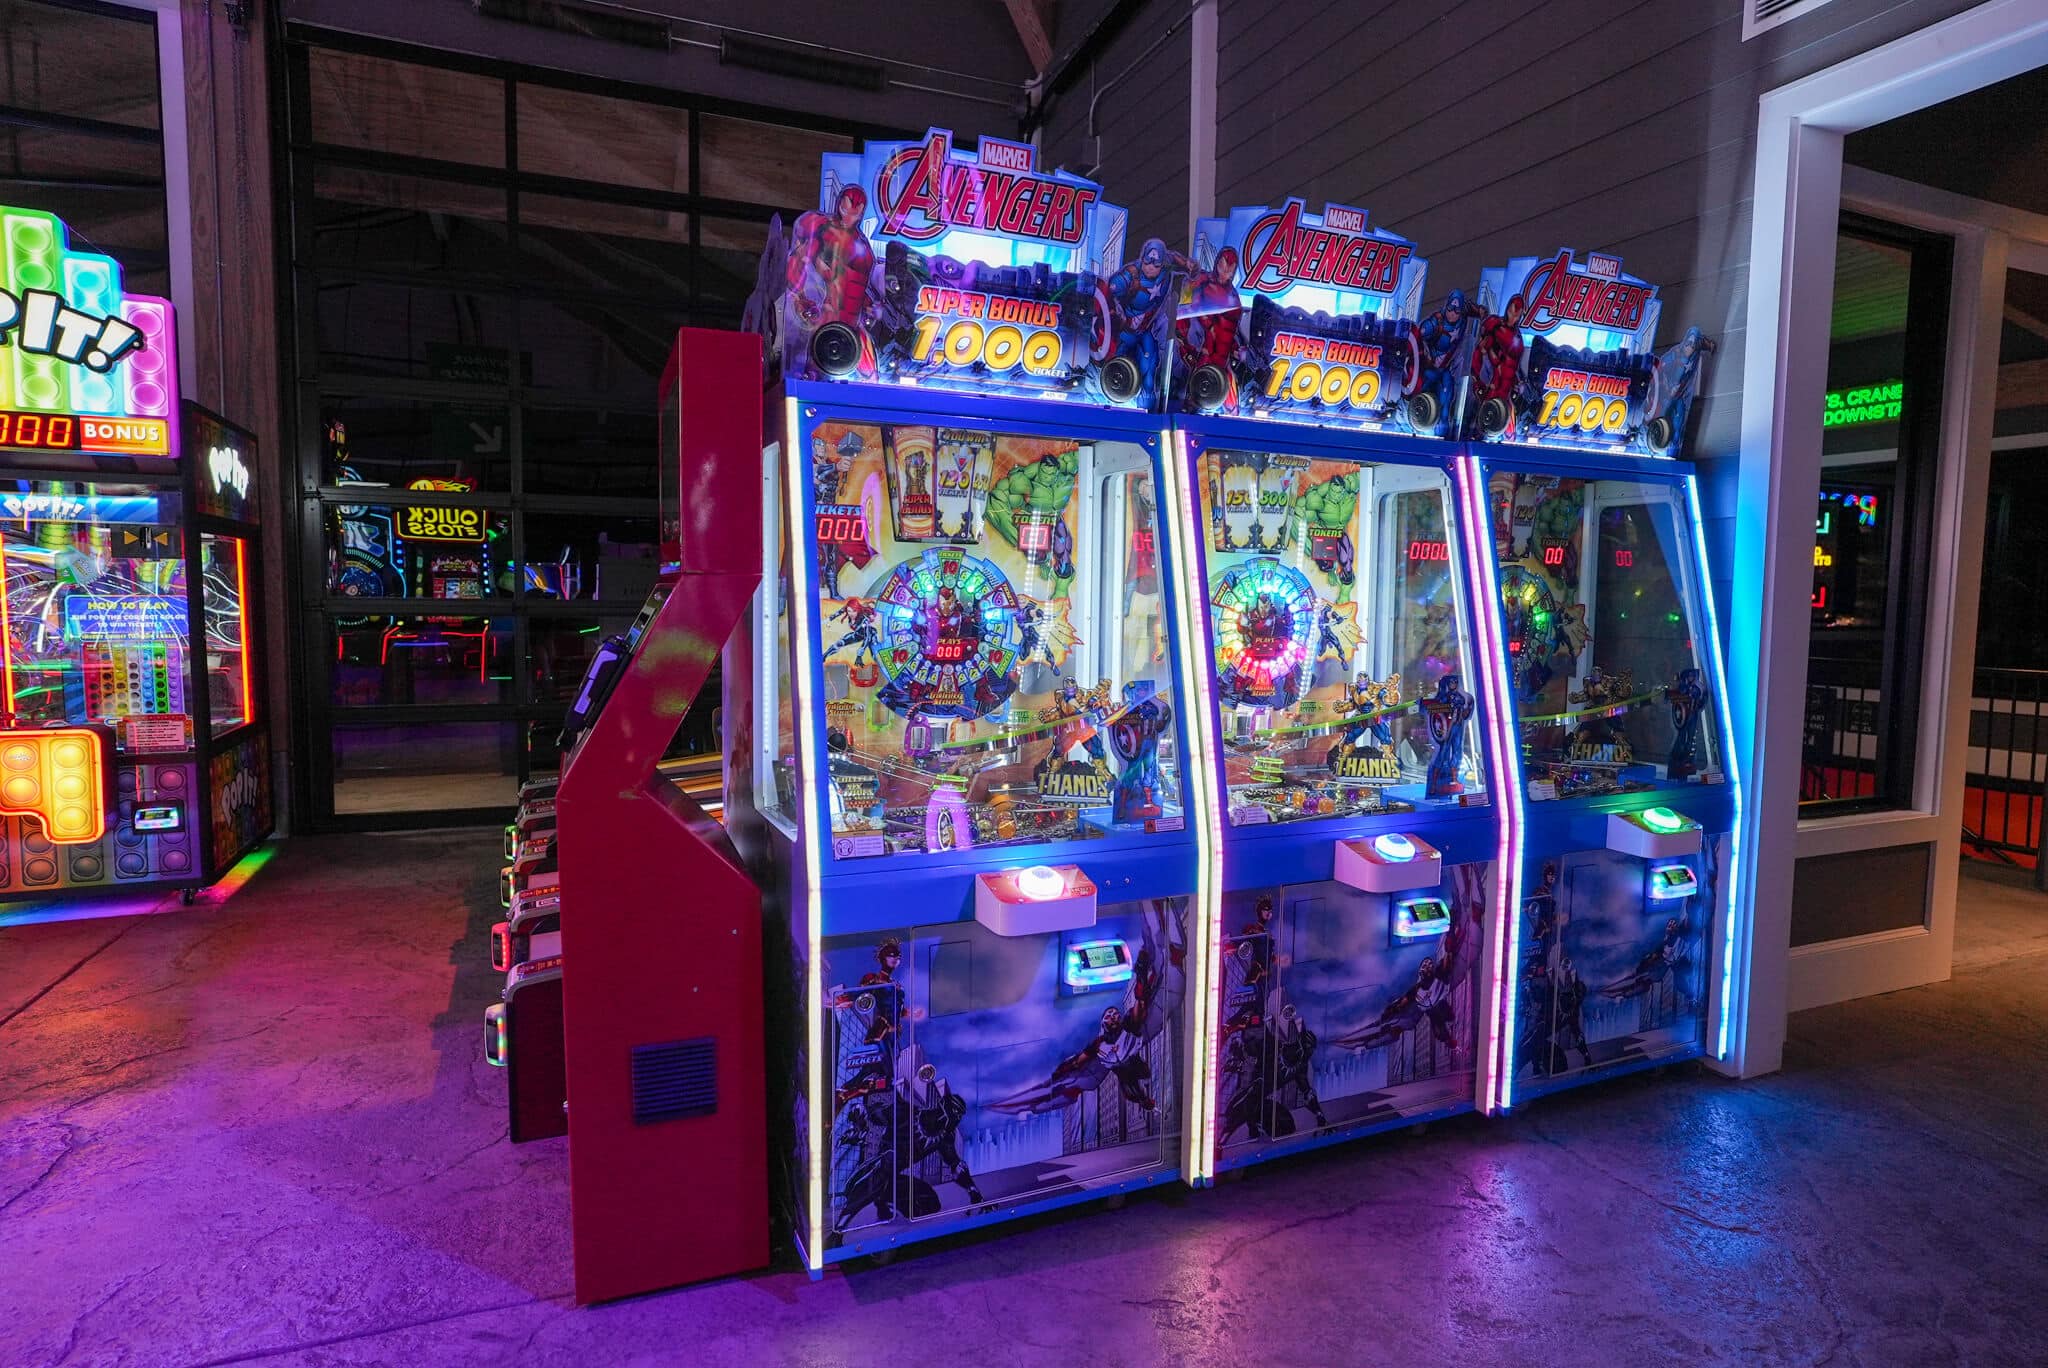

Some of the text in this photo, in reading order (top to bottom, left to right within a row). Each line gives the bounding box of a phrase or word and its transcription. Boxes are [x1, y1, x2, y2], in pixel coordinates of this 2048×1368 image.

[984, 142, 1031, 171] MARVEL
[876, 135, 1098, 242] AVENGERS
[1328, 208, 1363, 232] MARVEL
[1243, 201, 1409, 293] AVENGERS
[1590, 257, 1619, 277] MARVEL
[1521, 252, 1653, 330] AVENGERS
[917, 287, 1061, 328] SUPER BONUS
[912, 316, 1062, 374] 1,000
[1272, 332, 1381, 367] SUPER BONUS
[1033, 367, 1066, 378] TICKETS
[1266, 359, 1380, 406] 1,000
[1546, 369, 1631, 396] SUPER BONUS
[1357, 400, 1383, 410] TICKETS
[1537, 391, 1627, 431] 1,000
[84, 423, 160, 441] BONUS
[938, 470, 971, 488] 120
[3, 494, 85, 518] POP IT!
[1260, 490, 1288, 506] 300
[818, 518, 865, 540] 000
[1310, 528, 1343, 538] TOKENS
[1545, 548, 1563, 565] 00
[943, 560, 959, 575] 10
[88, 602, 118, 610] HOW
[892, 649, 909, 665] 10
[936, 646, 961, 658] 000
[1572, 743, 1633, 762] THANOS
[1337, 757, 1401, 778] THANOS
[1038, 772, 1109, 798] THANOS
[847, 1055, 882, 1067] TICKETS
